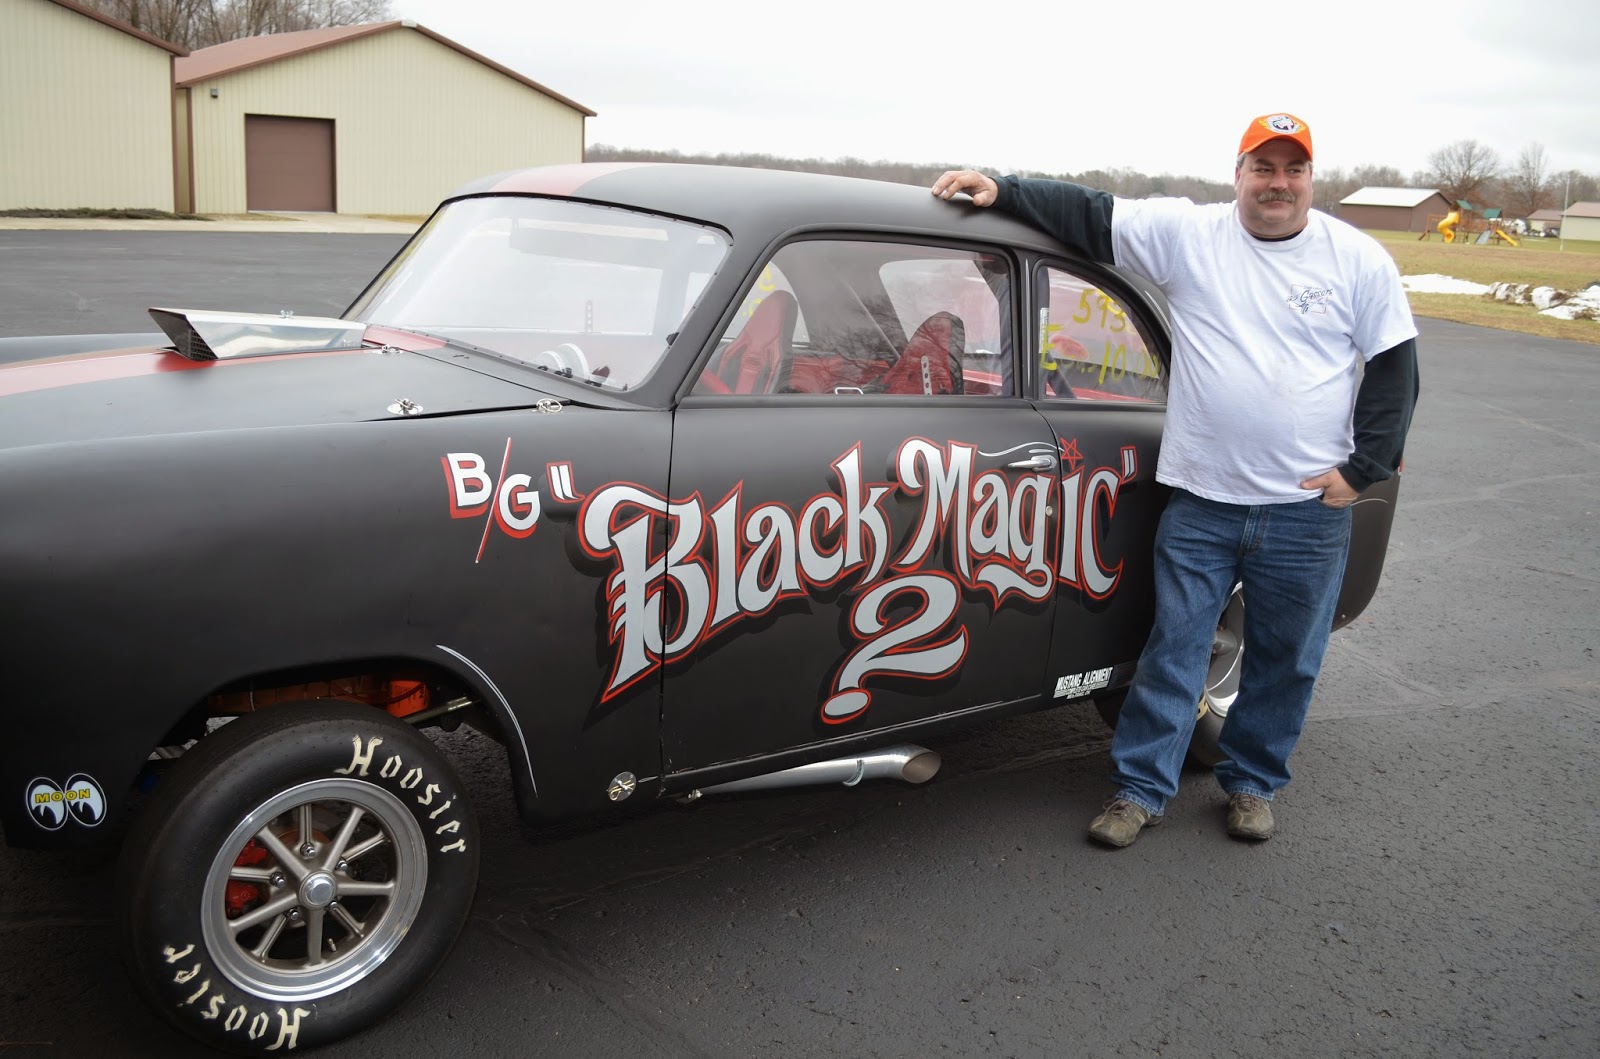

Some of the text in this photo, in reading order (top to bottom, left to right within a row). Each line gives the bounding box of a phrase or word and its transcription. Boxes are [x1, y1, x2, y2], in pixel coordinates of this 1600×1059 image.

[821, 569, 969, 724] 2
[35, 788, 91, 804] MOON
[334, 734, 467, 854] Hoosier
[163, 943, 311, 1051] Hoosier
